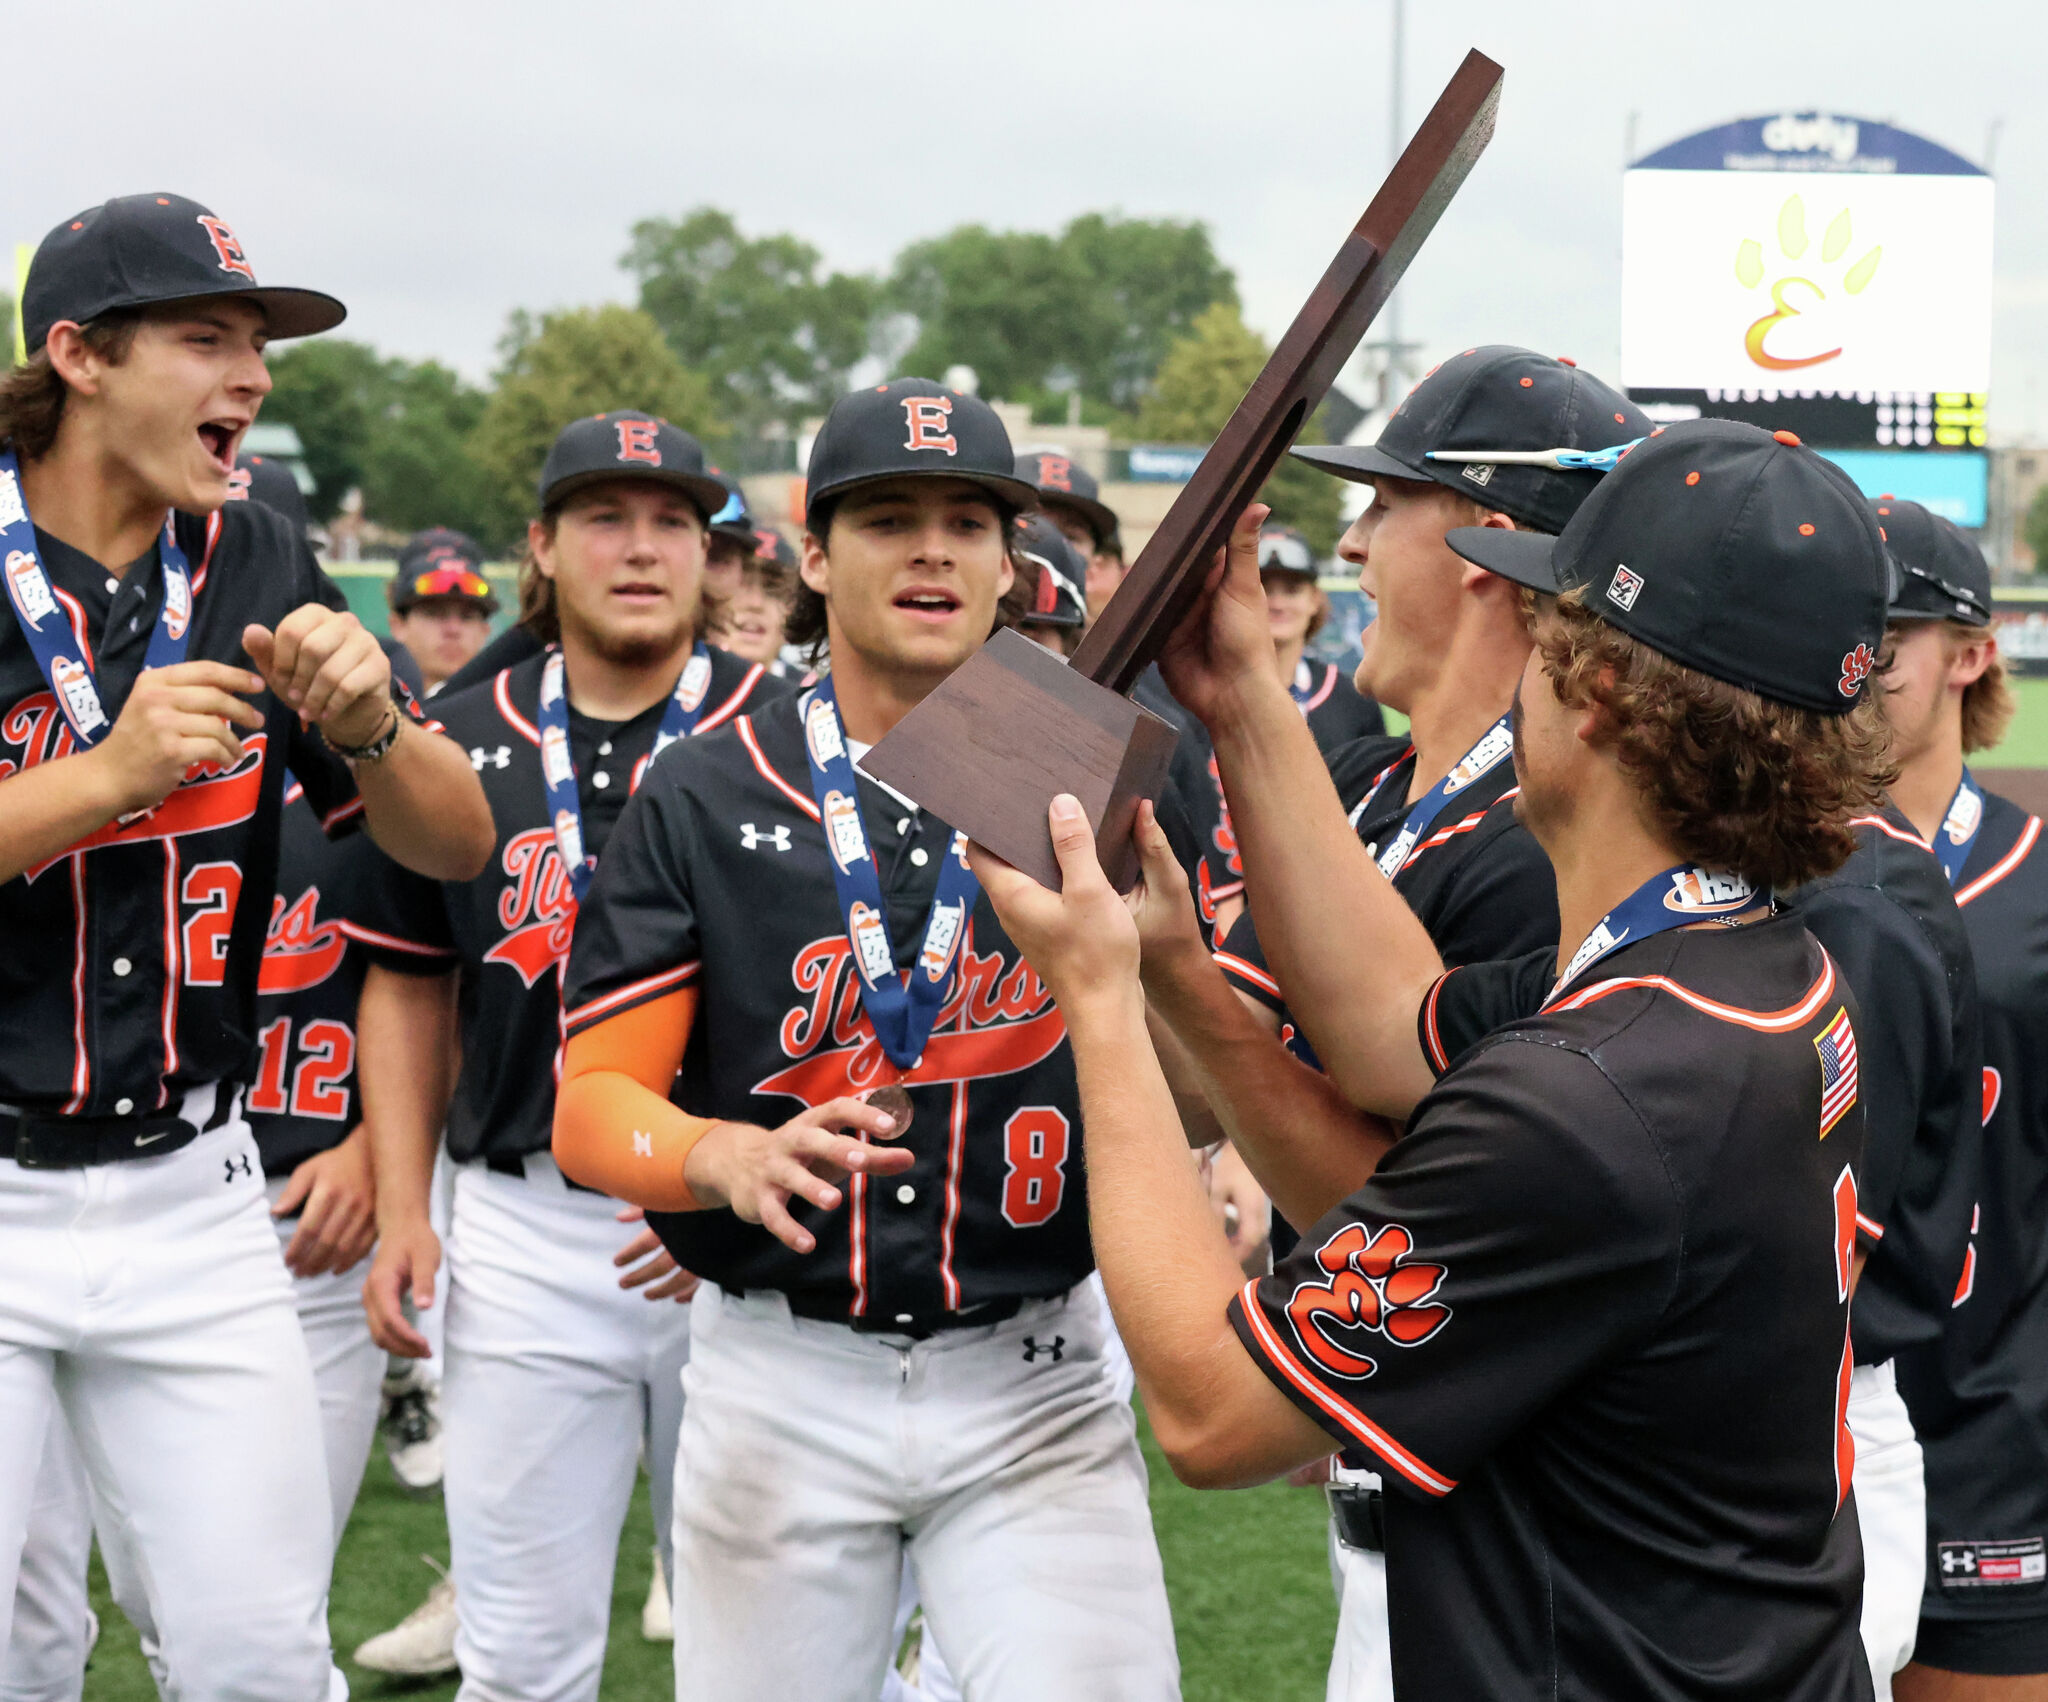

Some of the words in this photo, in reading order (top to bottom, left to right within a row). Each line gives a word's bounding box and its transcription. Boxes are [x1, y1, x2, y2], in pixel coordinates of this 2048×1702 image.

[614, 419, 662, 467] E
[900, 396, 958, 456] E
[1037, 455, 1072, 492] E
[181, 860, 243, 986] 2
[246, 1014, 356, 1121] 12
[1001, 1105, 1070, 1228] 8
